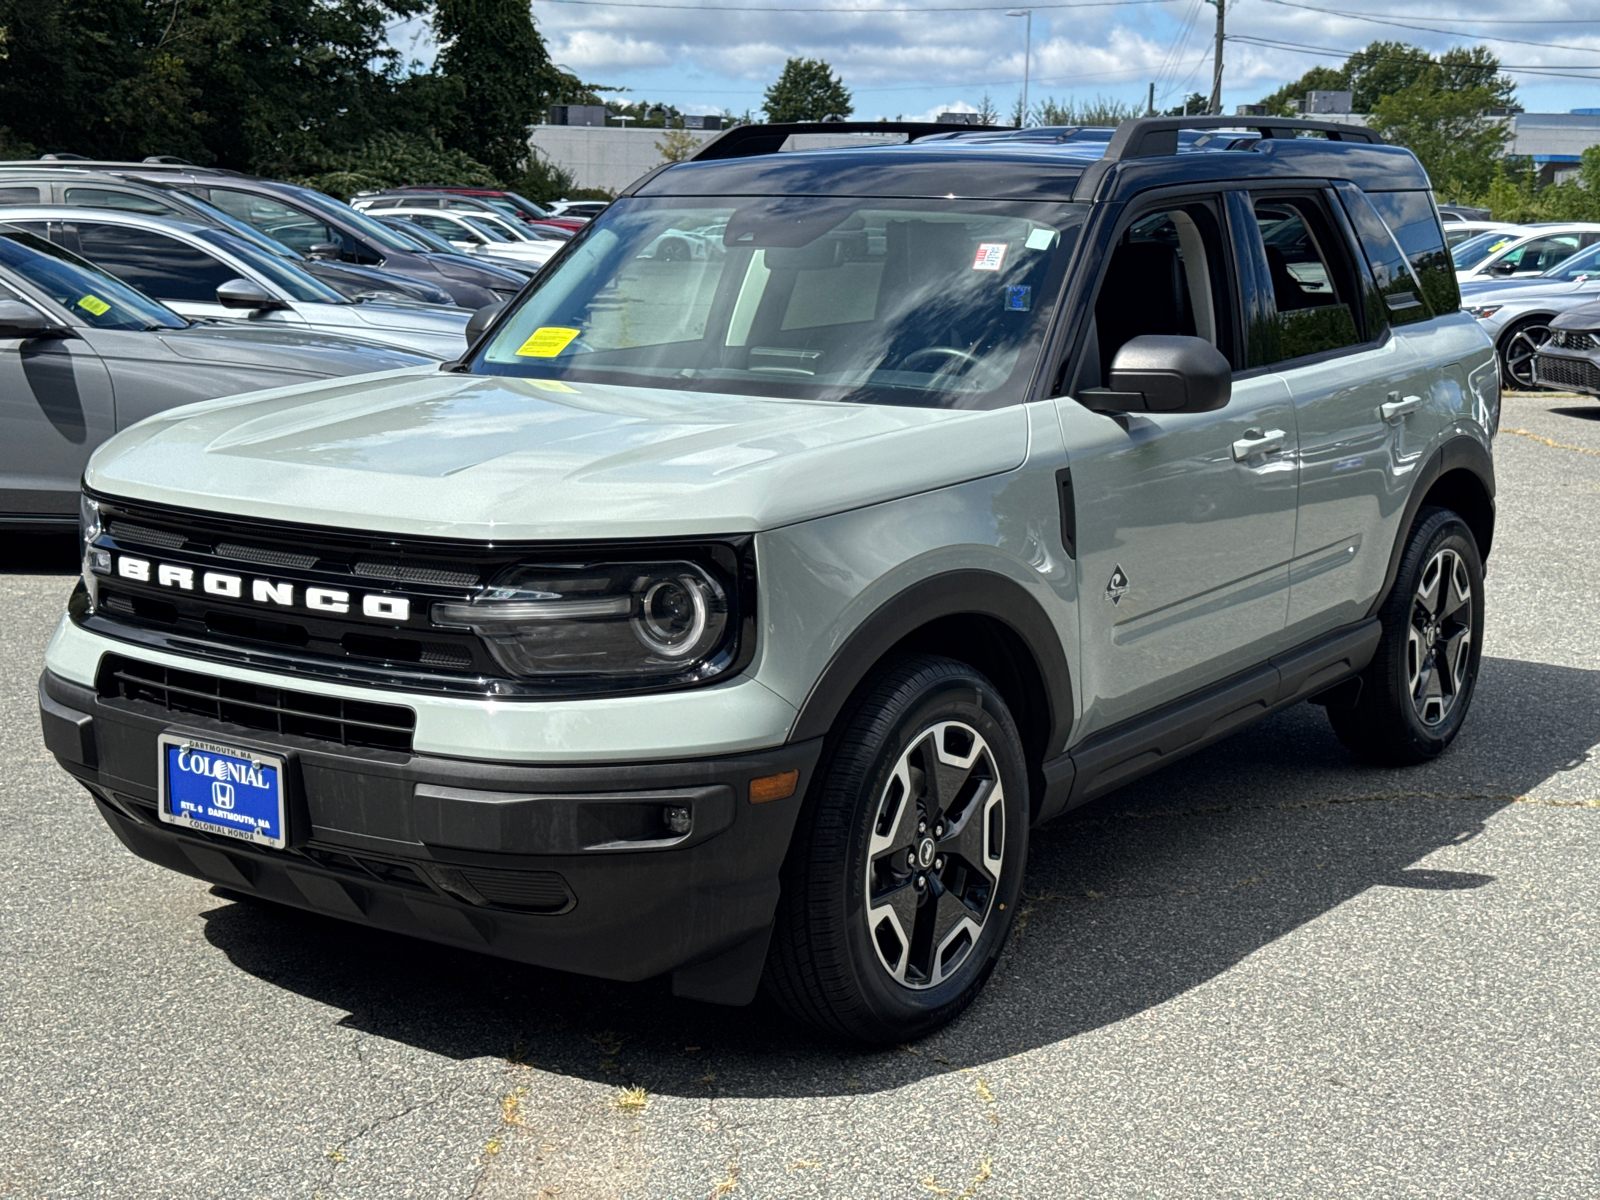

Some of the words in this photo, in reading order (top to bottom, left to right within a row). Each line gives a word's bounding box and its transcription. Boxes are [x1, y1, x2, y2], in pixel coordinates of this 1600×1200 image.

[117, 555, 411, 621] BRONCO
[240, 751, 252, 760] MA
[178, 752, 269, 789] COLONIAL
[180, 800, 197, 812] RTE.
[198, 805, 203, 814] 6
[257, 818, 271, 829] MA
[189, 820, 226, 835] COLONIAL
[227, 828, 255, 841] HONDA
